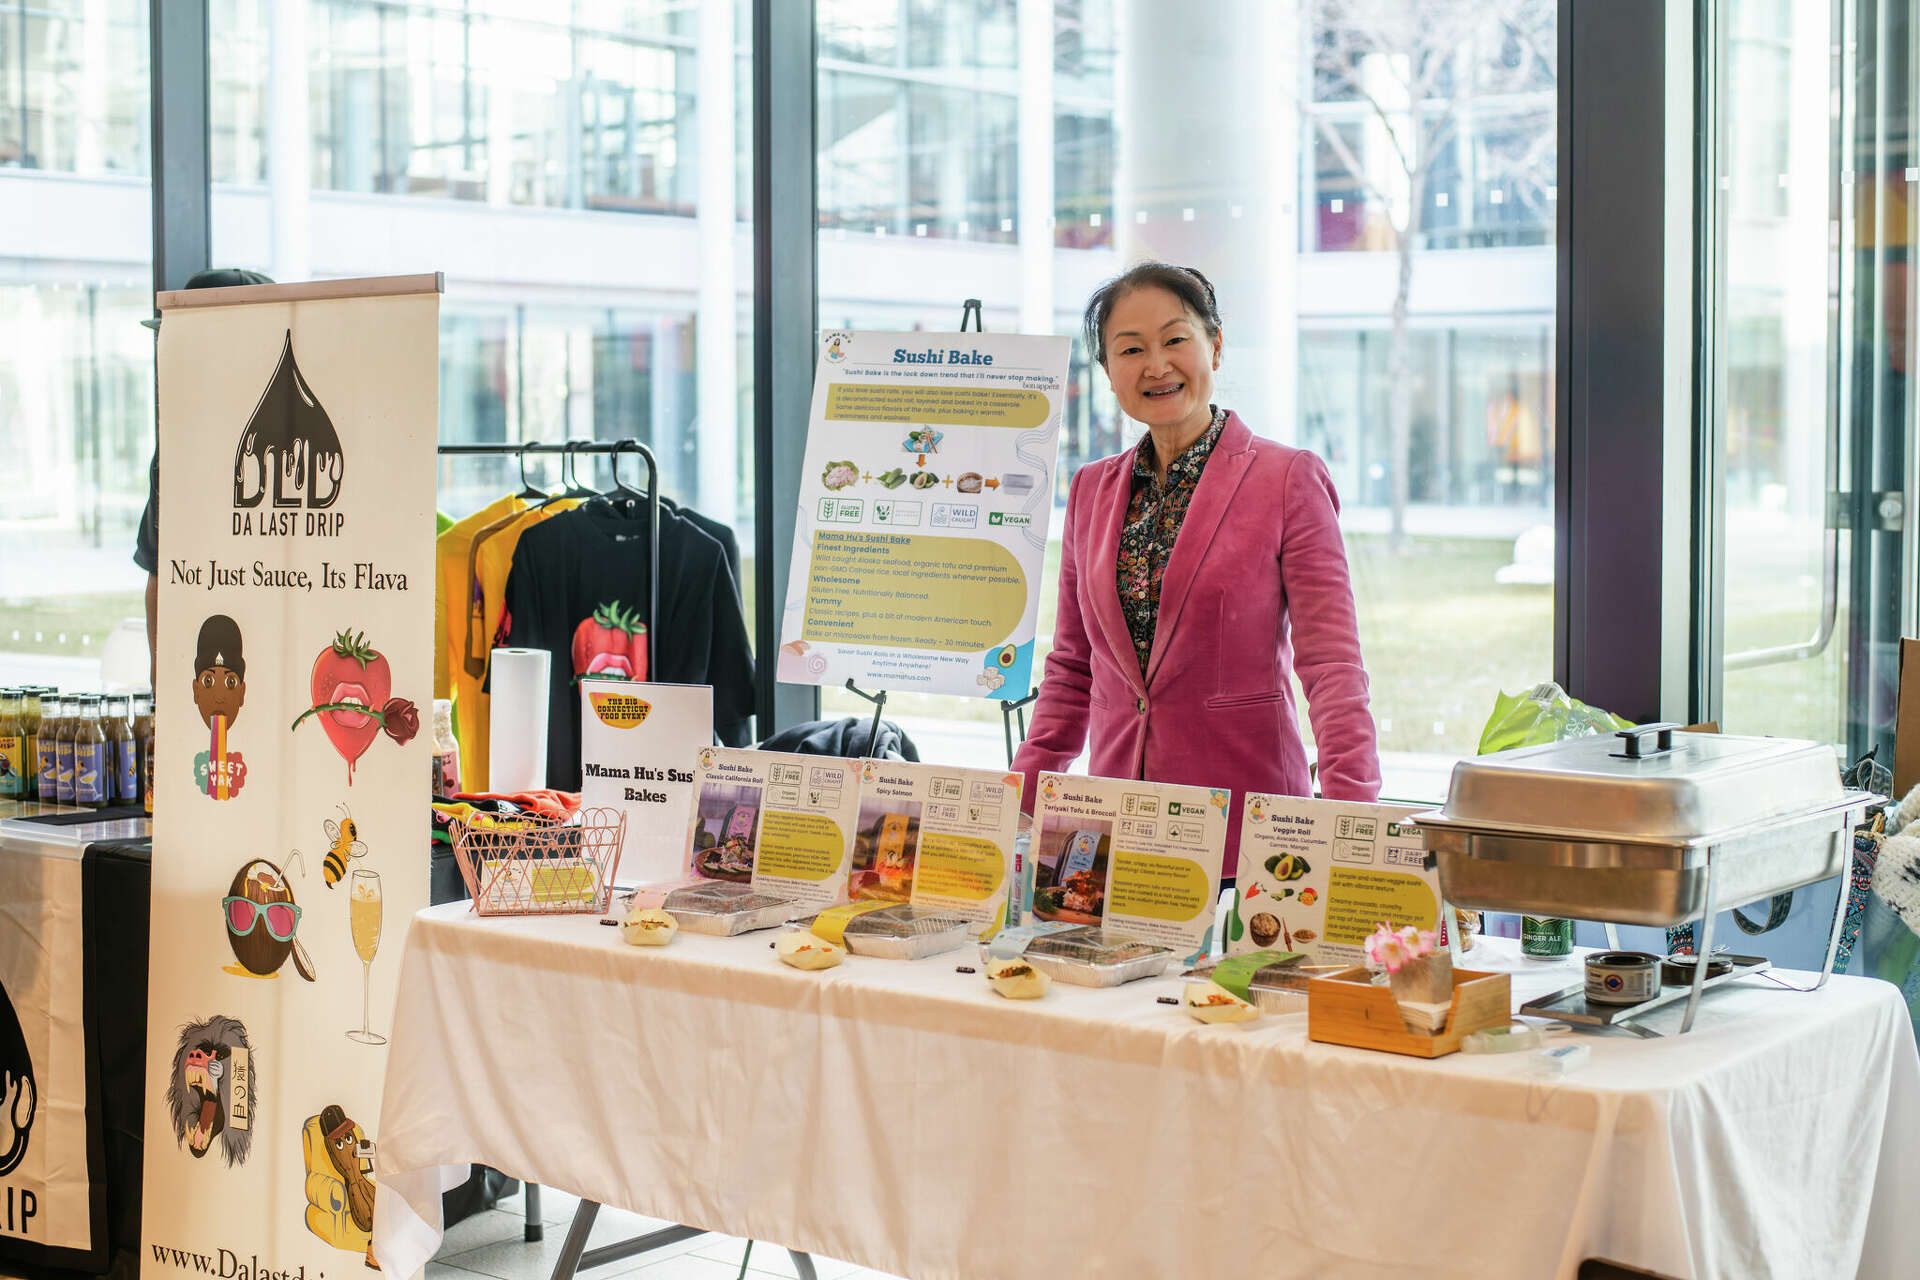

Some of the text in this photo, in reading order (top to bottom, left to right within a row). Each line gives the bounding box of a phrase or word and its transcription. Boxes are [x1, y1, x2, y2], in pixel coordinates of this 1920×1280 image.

[894, 348, 993, 366] Sushi Bake
[233, 445, 344, 509] DLD
[840, 510, 859, 518] FREE
[232, 512, 344, 537] DA LAST DRIP
[818, 532, 844, 540] Mama
[866, 534, 888, 543] Sushi
[890, 536, 911, 544] Bake
[816, 544, 890, 555] Finest Ingredients
[170, 560, 408, 592] Not Just Sauce, Its Flava
[813, 575, 860, 584] Wholesome
[810, 597, 842, 606] Yummy
[807, 619, 854, 627] Convenient
[200, 760, 244, 776] SWEET
[585, 763, 696, 783] Mama Hu's Sus
[210, 774, 233, 788] YAK
[898, 778, 913, 786] Bake
[624, 788, 667, 803] Bakes
[1063, 793, 1083, 802] Sushi
[1044, 804, 1068, 812] Teriyaki
[1091, 808, 1116, 817] Broccoli
[1182, 807, 1204, 815] VEGAN
[1272, 815, 1314, 824] Sushi Bake
[1273, 827, 1296, 835] Veggie
[0, 1186, 37, 1234] IP
